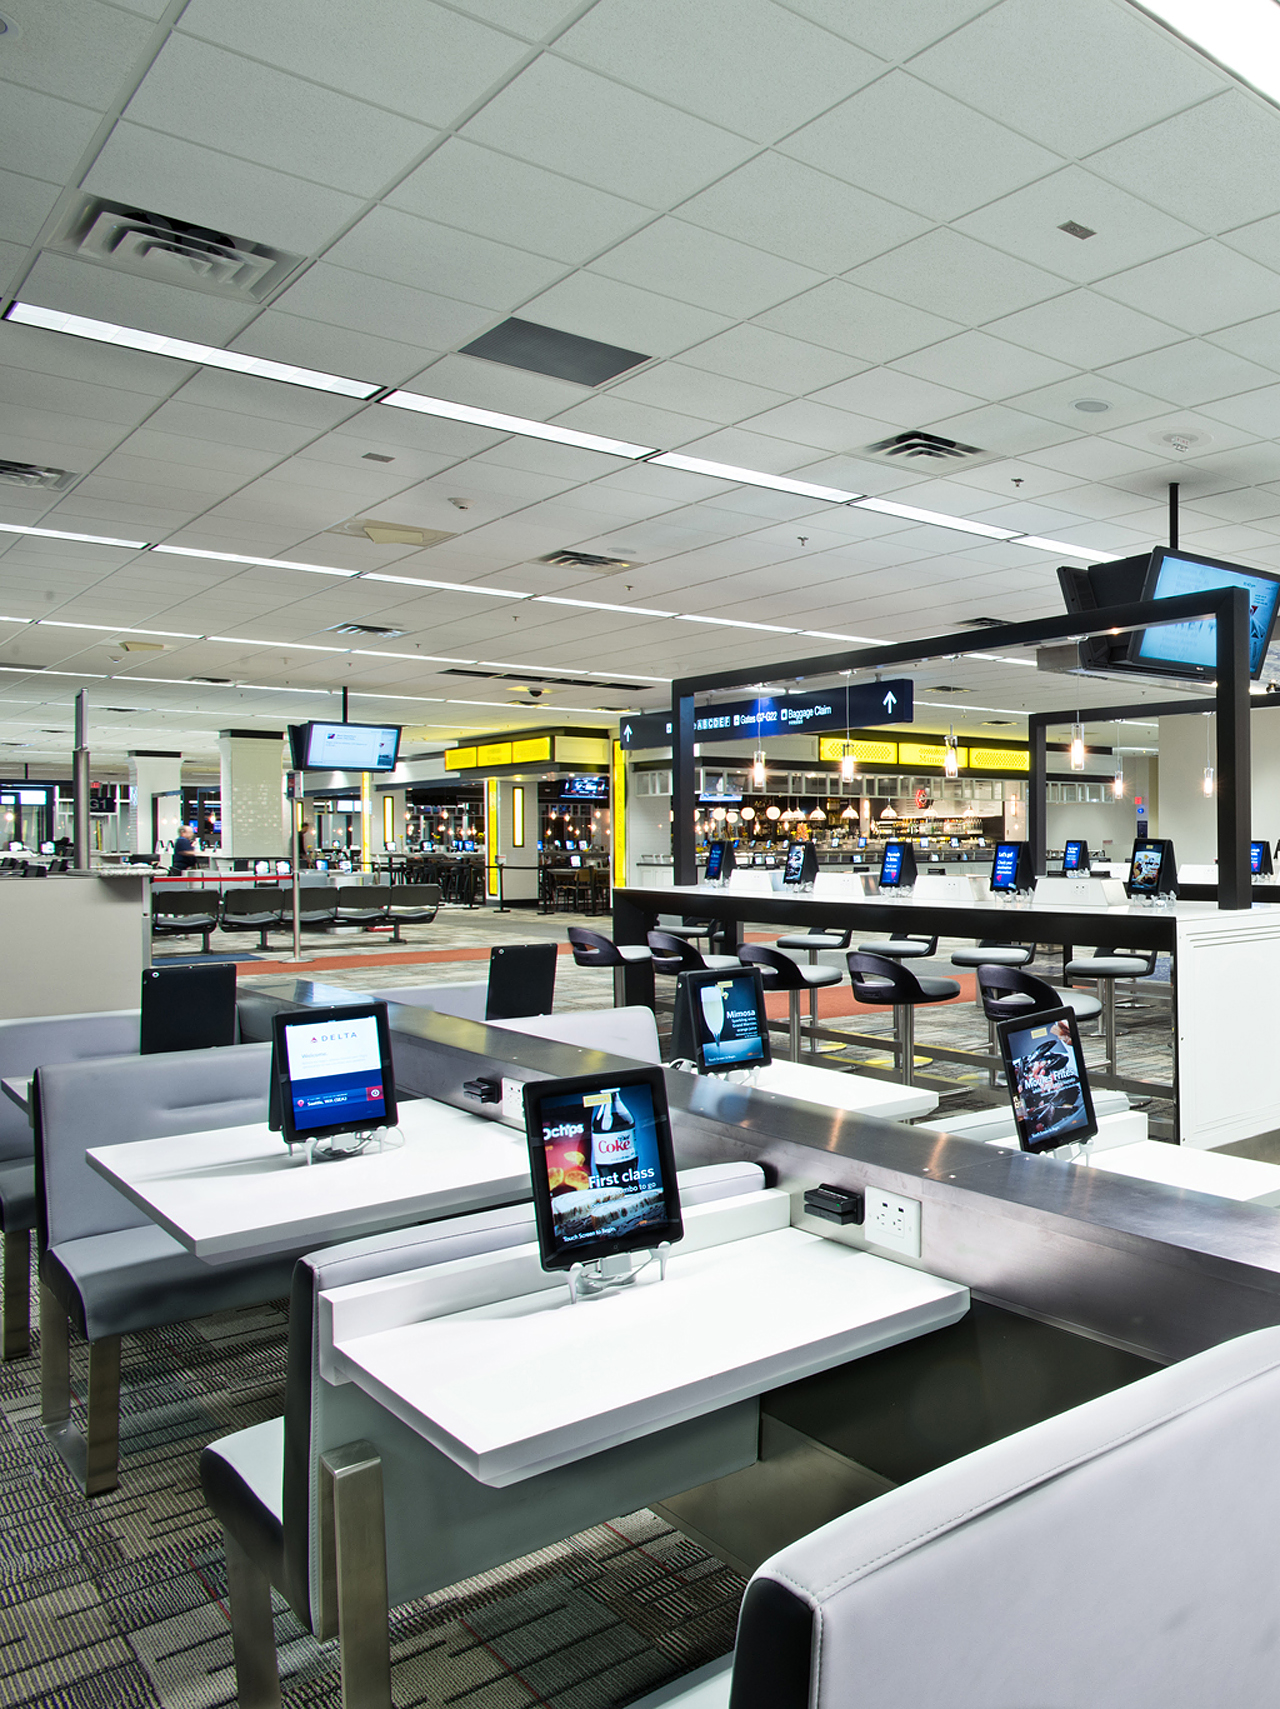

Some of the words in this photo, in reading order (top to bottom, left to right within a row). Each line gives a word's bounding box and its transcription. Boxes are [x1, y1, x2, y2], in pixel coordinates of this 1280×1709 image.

[740, 714, 756, 725] Gates
[788, 708, 814, 721] Baggage
[814, 705, 832, 716] Claim
[726, 1010, 756, 1019] Mimosa
[321, 1031, 358, 1042] DELTA
[598, 1139, 632, 1154] Coke
[588, 1172, 620, 1188] First
[621, 1167, 655, 1182] class
[647, 1182, 657, 1190] go
